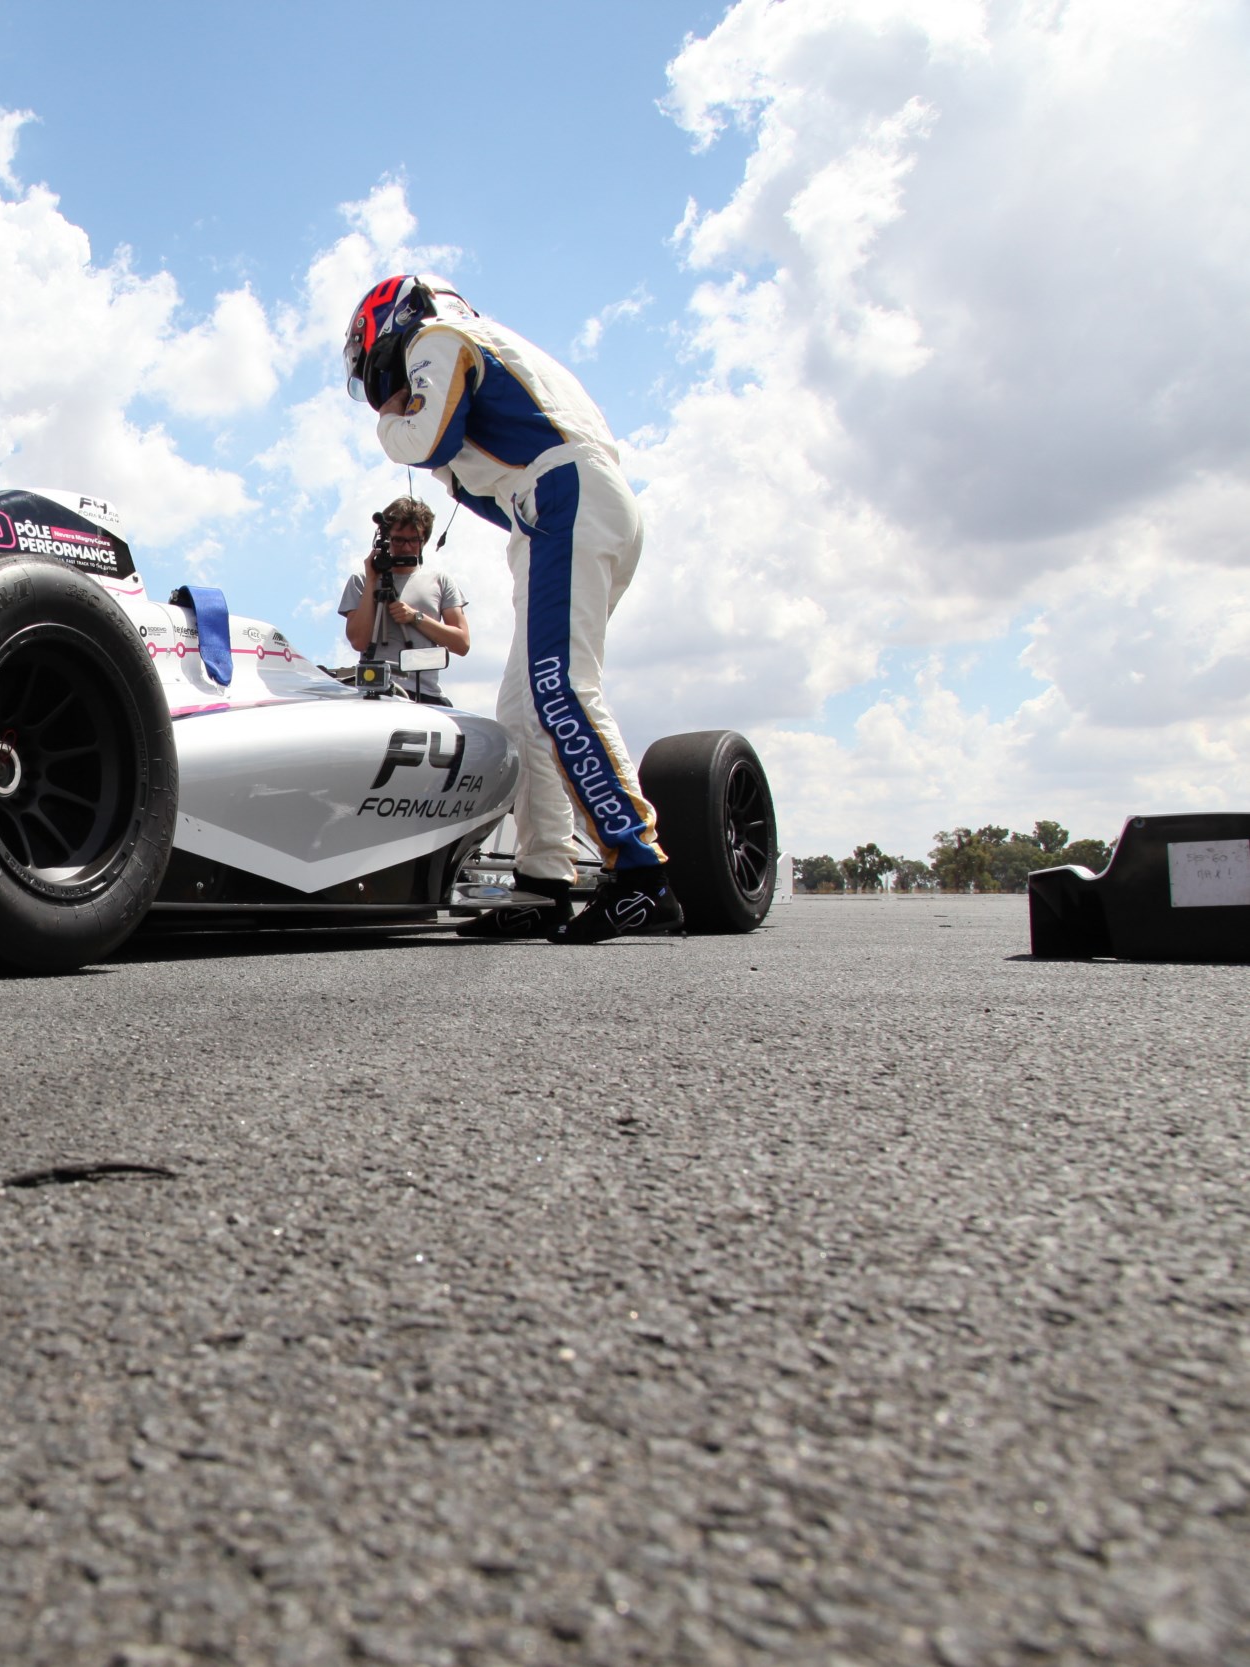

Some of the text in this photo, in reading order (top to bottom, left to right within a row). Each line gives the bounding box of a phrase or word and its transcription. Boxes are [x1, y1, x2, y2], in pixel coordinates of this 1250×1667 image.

[79, 496, 108, 514] F4
[14, 519, 52, 539] PÔLE
[18, 537, 117, 565] PERFORMANCE
[534, 655, 632, 835] cams.com.au
[370, 728, 483, 793] F4 FIA
[357, 797, 461, 818] FORMULA
